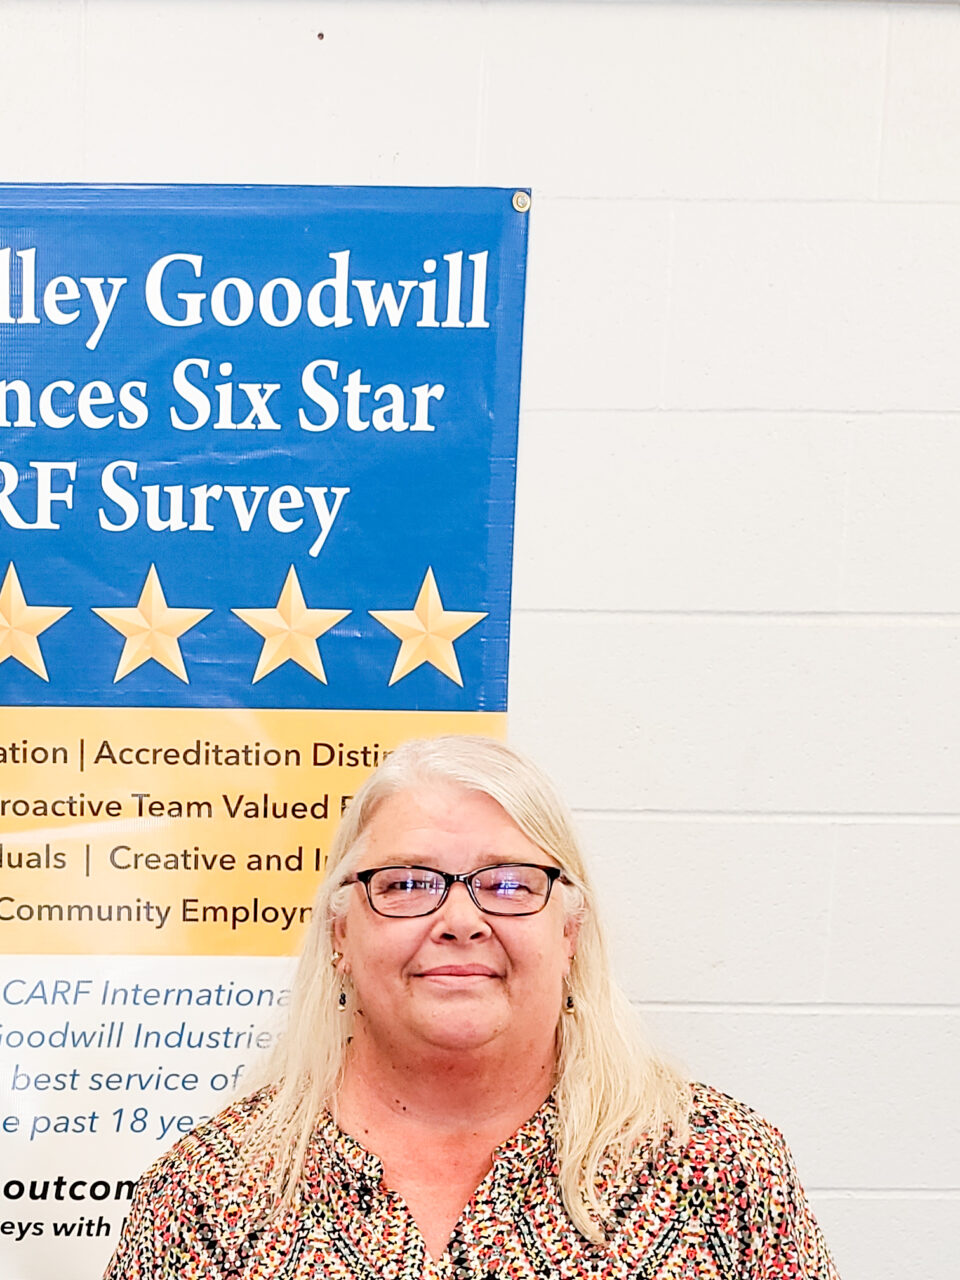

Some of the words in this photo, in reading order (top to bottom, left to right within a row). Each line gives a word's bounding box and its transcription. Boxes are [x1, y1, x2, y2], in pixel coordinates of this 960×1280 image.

[146, 251, 489, 327] Goodwill
[171, 359, 280, 430] Six
[299, 360, 444, 431] Star
[99, 461, 349, 556] Survey
[94, 740, 300, 766] Accreditation
[131, 794, 212, 818] Team
[222, 794, 328, 819] Valued
[110, 846, 235, 870] Creative
[247, 846, 302, 871] and
[3, 979, 93, 1005] CARF
[11, 1064, 80, 1091] best
[89, 1066, 198, 1091] service
[210, 1064, 245, 1091] of
[30, 1111, 99, 1141] past
[113, 1107, 148, 1133] 18
[156, 1115, 210, 1141] ye
[53, 1216, 110, 1237] with
